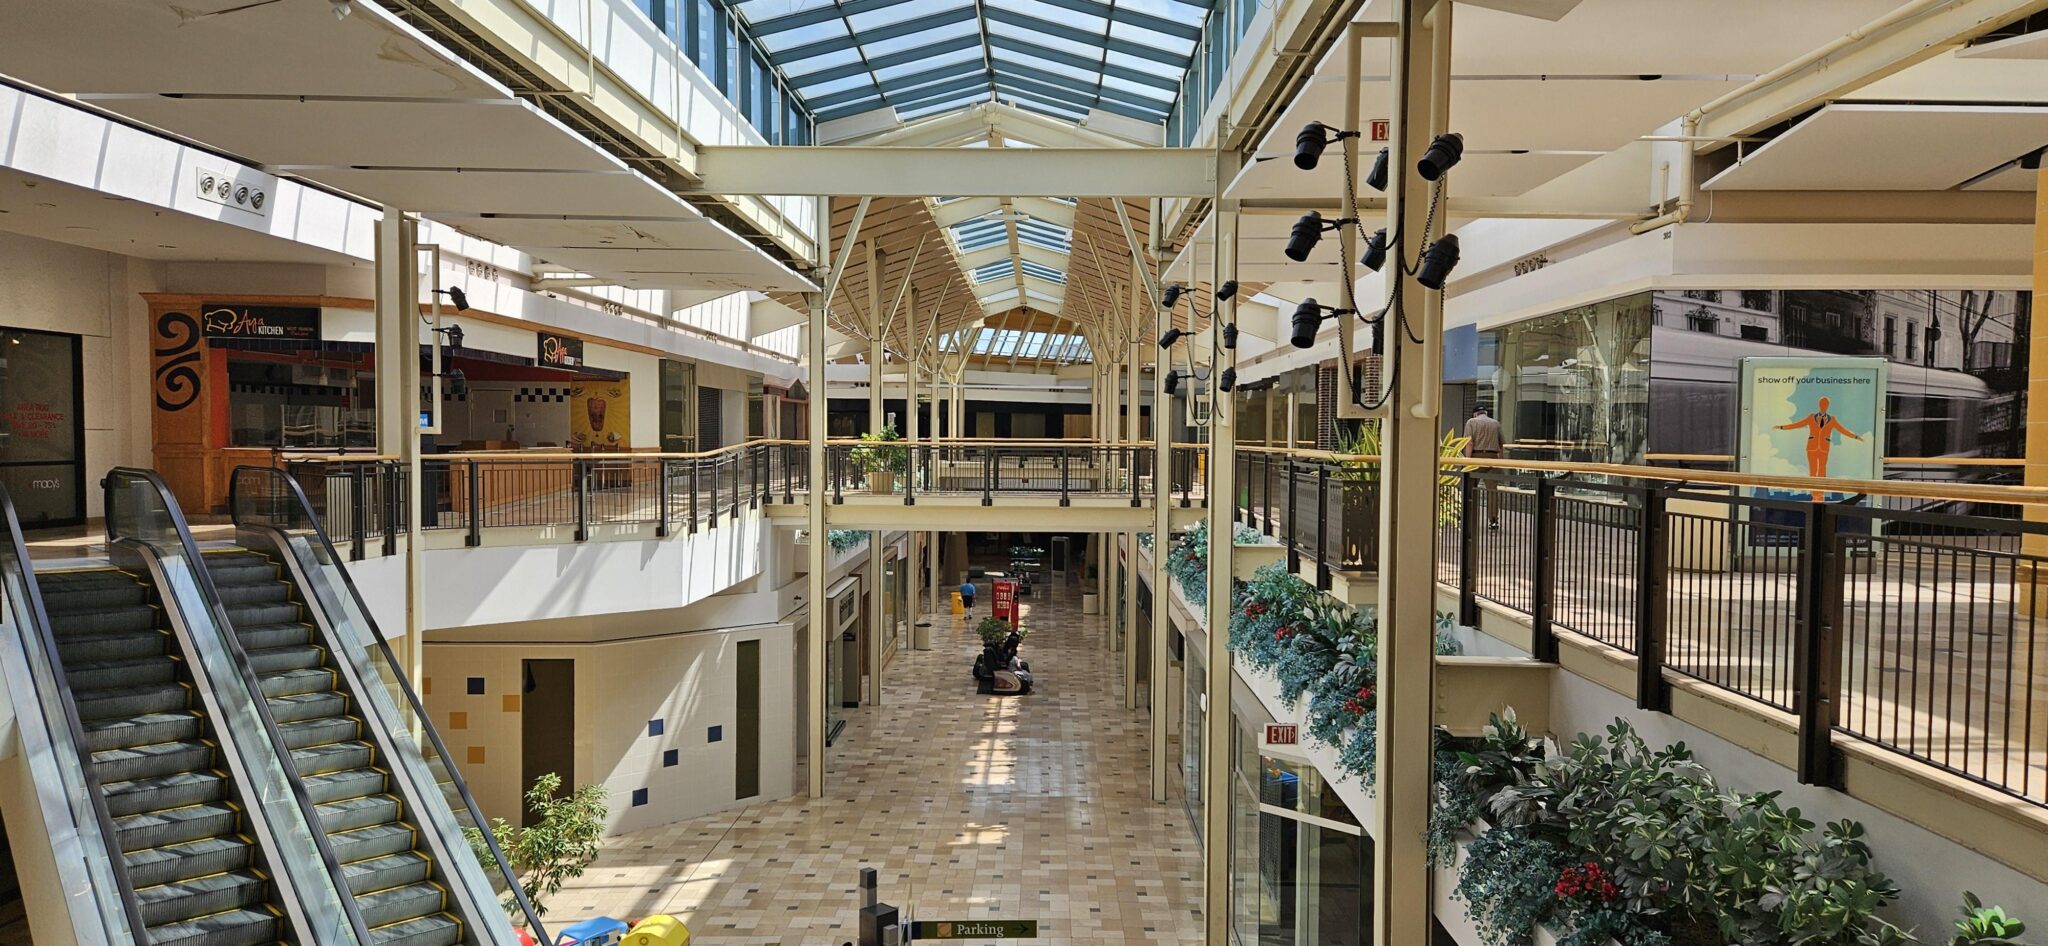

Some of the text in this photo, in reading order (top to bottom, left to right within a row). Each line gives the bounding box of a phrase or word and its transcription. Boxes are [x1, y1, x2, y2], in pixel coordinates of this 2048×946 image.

[1377, 122, 1389, 140] EX
[233, 309, 284, 335] Aya KITCHEN
[1757, 376, 1781, 384] show
[1782, 376, 1795, 384] off
[1816, 376, 1852, 384] business
[1271, 726, 1293, 744] EXIT
[957, 923, 1004, 937] Parking
